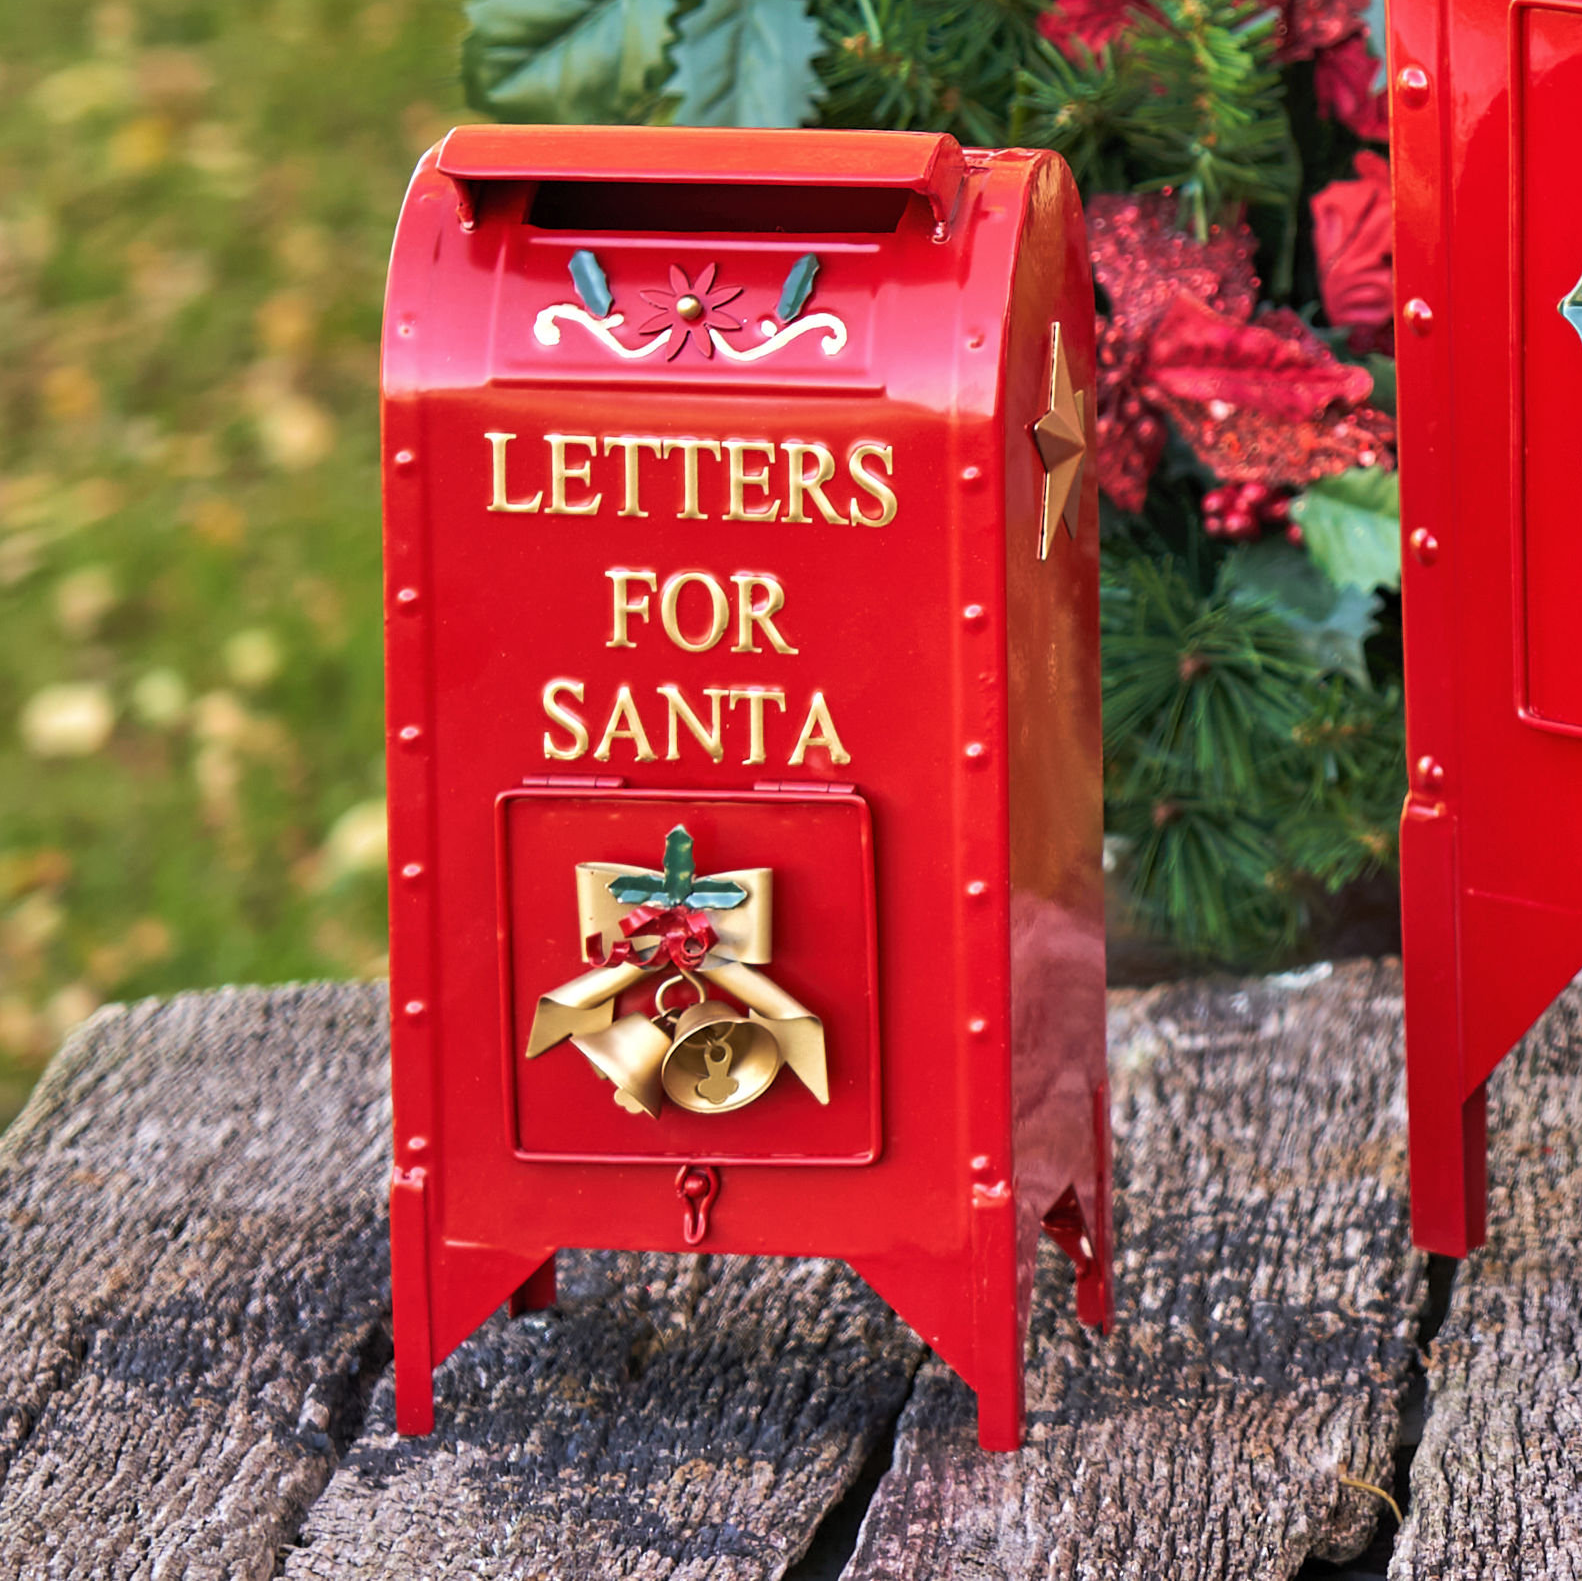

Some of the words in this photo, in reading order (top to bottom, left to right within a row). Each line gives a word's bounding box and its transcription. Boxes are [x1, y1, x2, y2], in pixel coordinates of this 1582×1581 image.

[484, 431, 898, 527] LETTERS
[604, 569, 799, 655] FOR
[542, 678, 851, 766] SANTA
